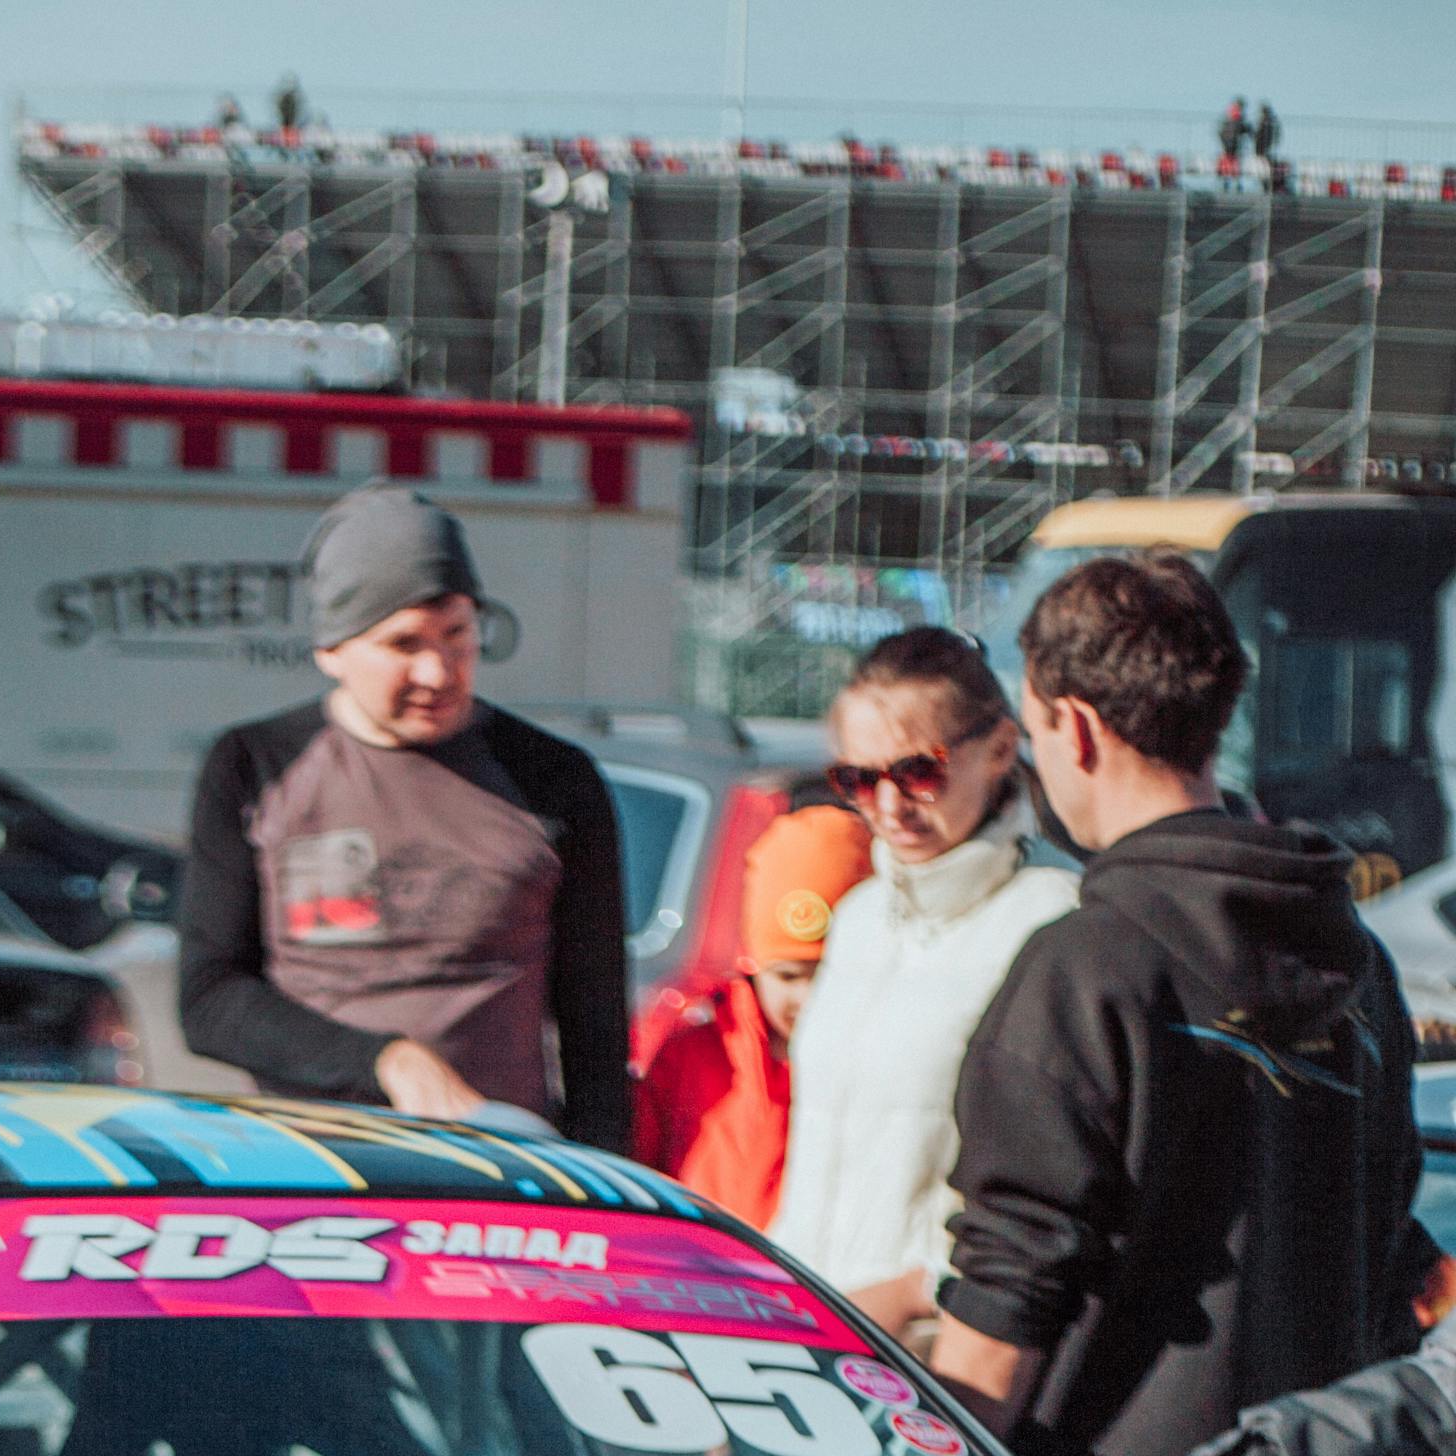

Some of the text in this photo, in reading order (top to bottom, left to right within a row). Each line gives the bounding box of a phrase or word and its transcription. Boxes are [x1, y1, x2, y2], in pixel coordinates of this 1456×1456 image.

[38, 560, 308, 650] STREET
[19, 1213, 398, 1282] RDS
[401, 1219, 610, 1270] ЗАПАД
